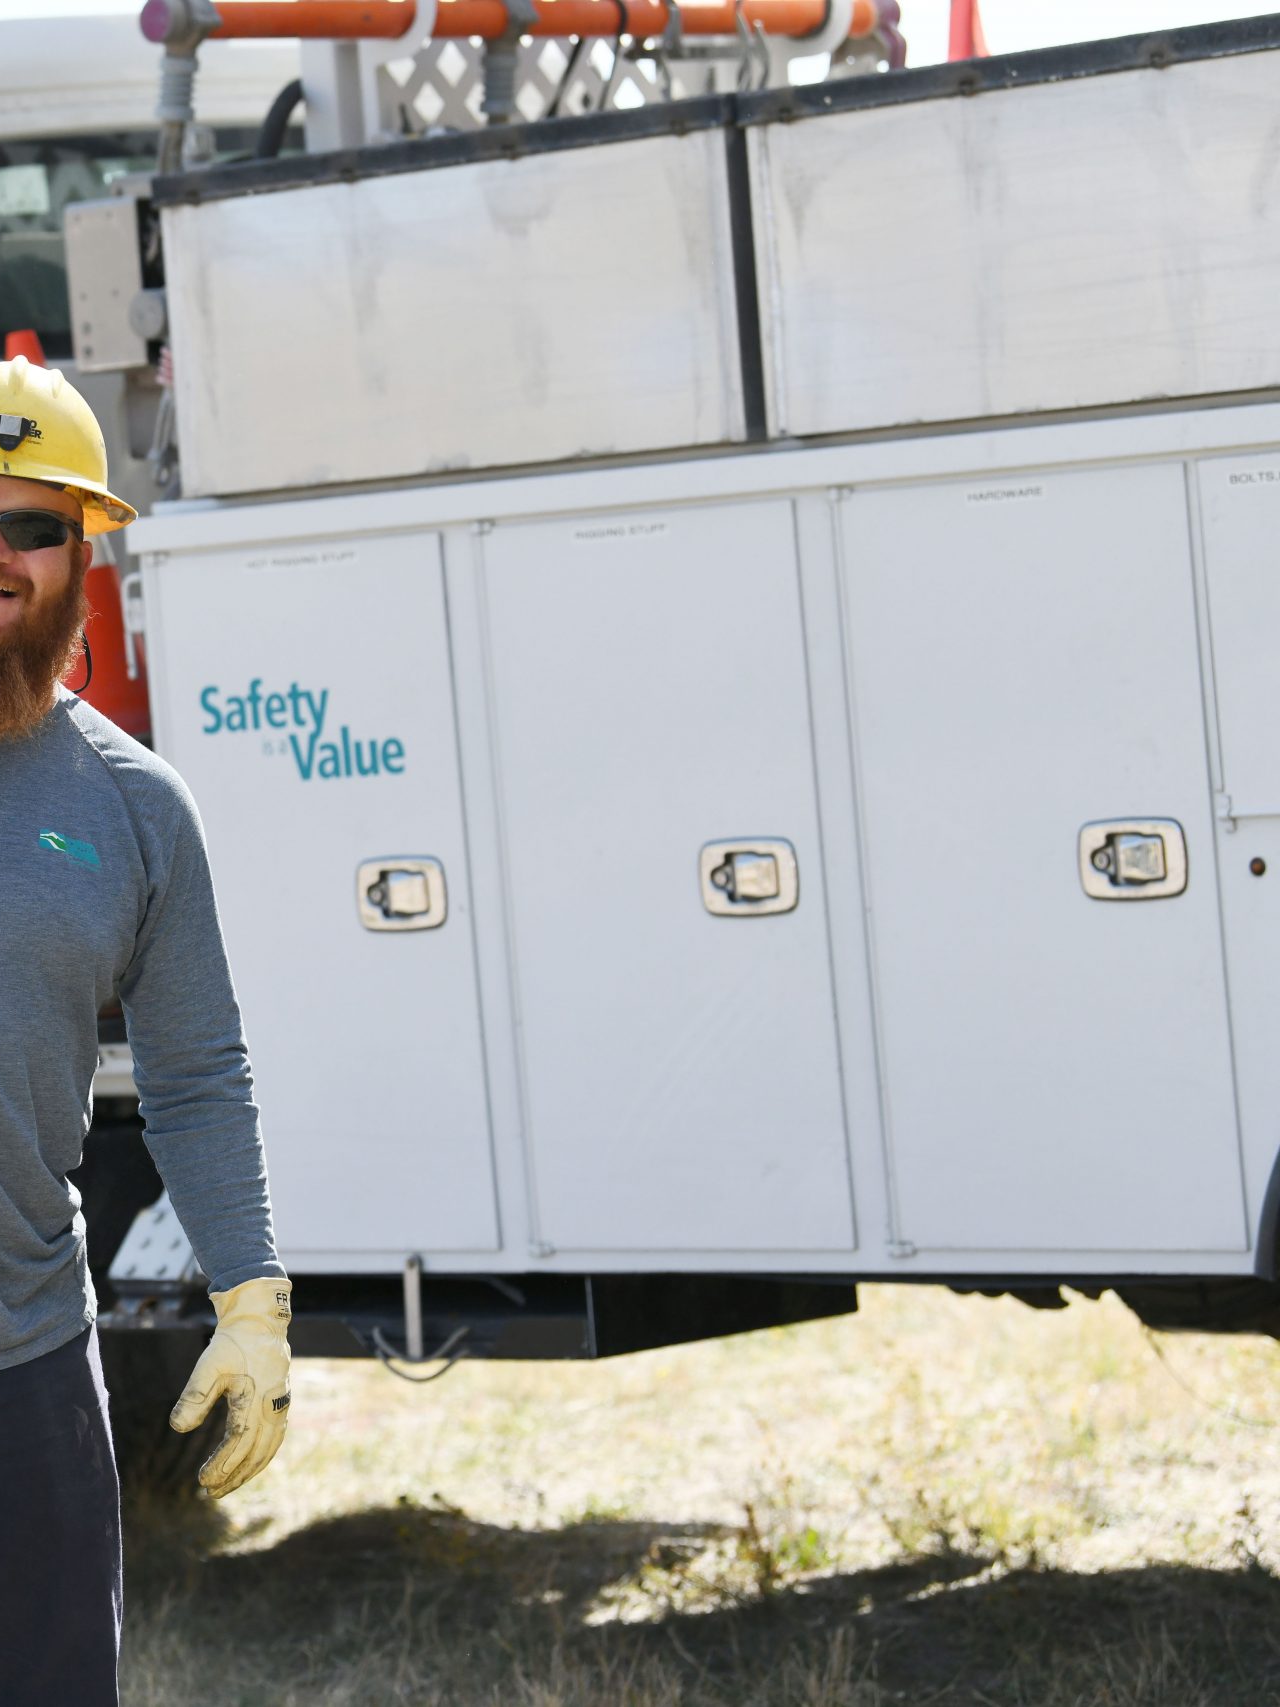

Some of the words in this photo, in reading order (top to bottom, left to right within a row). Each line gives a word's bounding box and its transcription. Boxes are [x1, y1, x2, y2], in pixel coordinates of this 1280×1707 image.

[1229, 470, 1280, 485] BOLTS,
[967, 486, 1042, 502] HARDWARE
[200, 678, 328, 739] Safety
[288, 725, 405, 780] Value
[276, 1292, 288, 1305] FR
